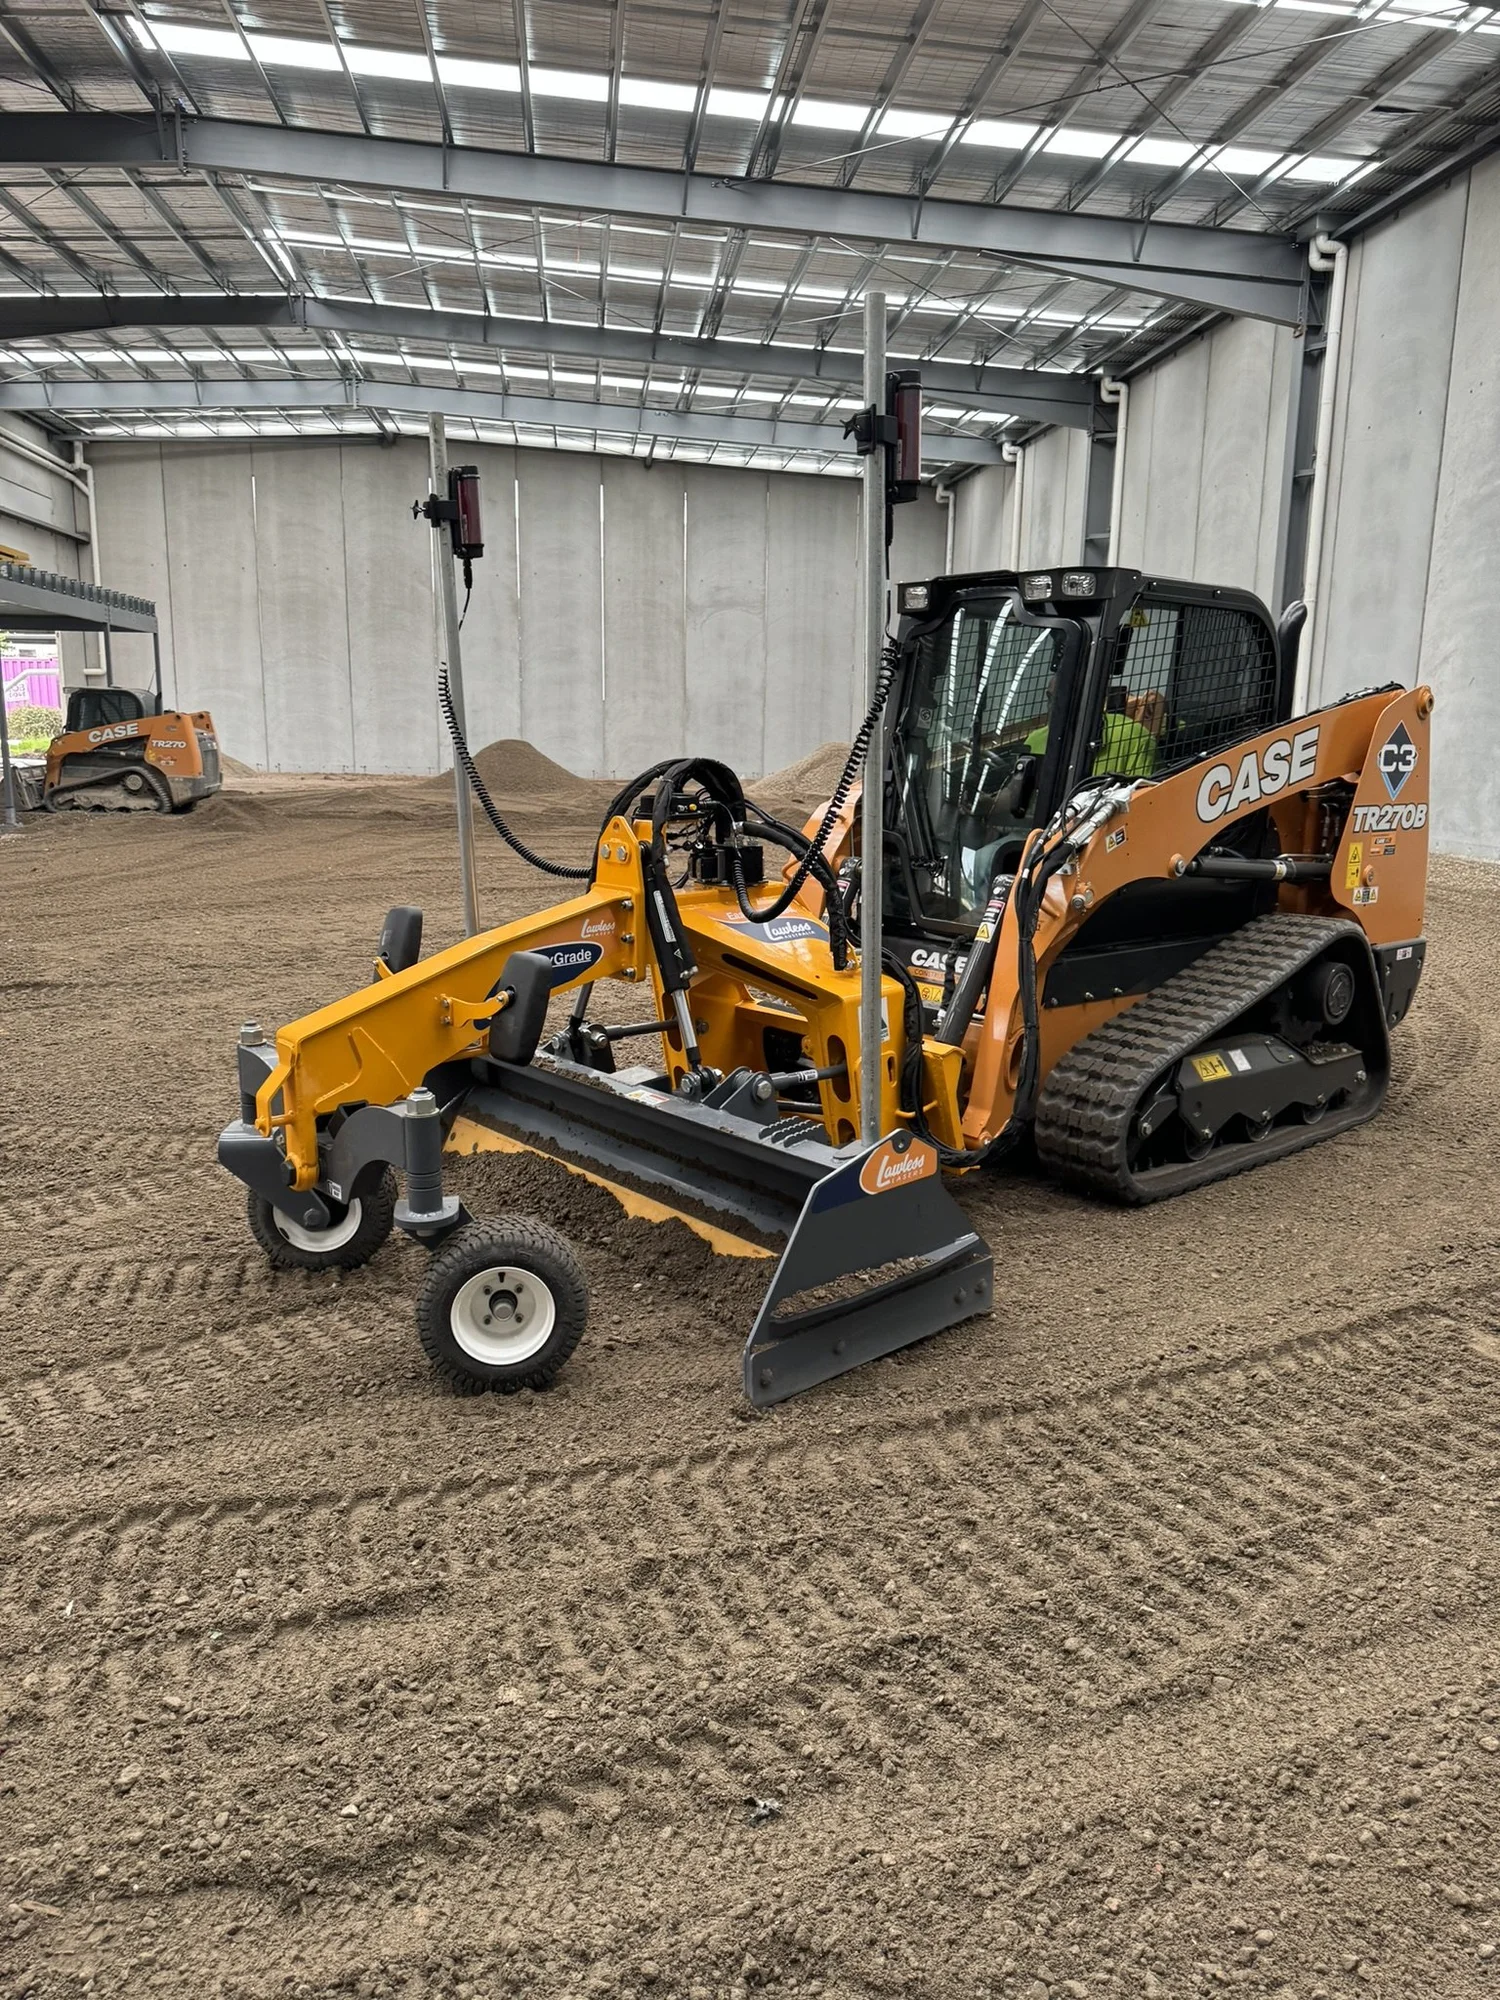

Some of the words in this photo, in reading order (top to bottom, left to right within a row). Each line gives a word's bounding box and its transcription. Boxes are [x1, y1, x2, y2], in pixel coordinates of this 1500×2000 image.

[88, 722, 139, 743] CASE
[151, 739, 187, 748] TR270
[1379, 744, 1416, 772] C3
[1196, 724, 1320, 823] CASE
[1352, 803, 1429, 833] TR270B
[581, 918, 616, 938] Lawless
[763, 921, 812, 940] Lawless
[784, 930, 816, 939] AUSTRALIA
[550, 949, 592, 965] Grade
[876, 1153, 925, 1188] Lawless
